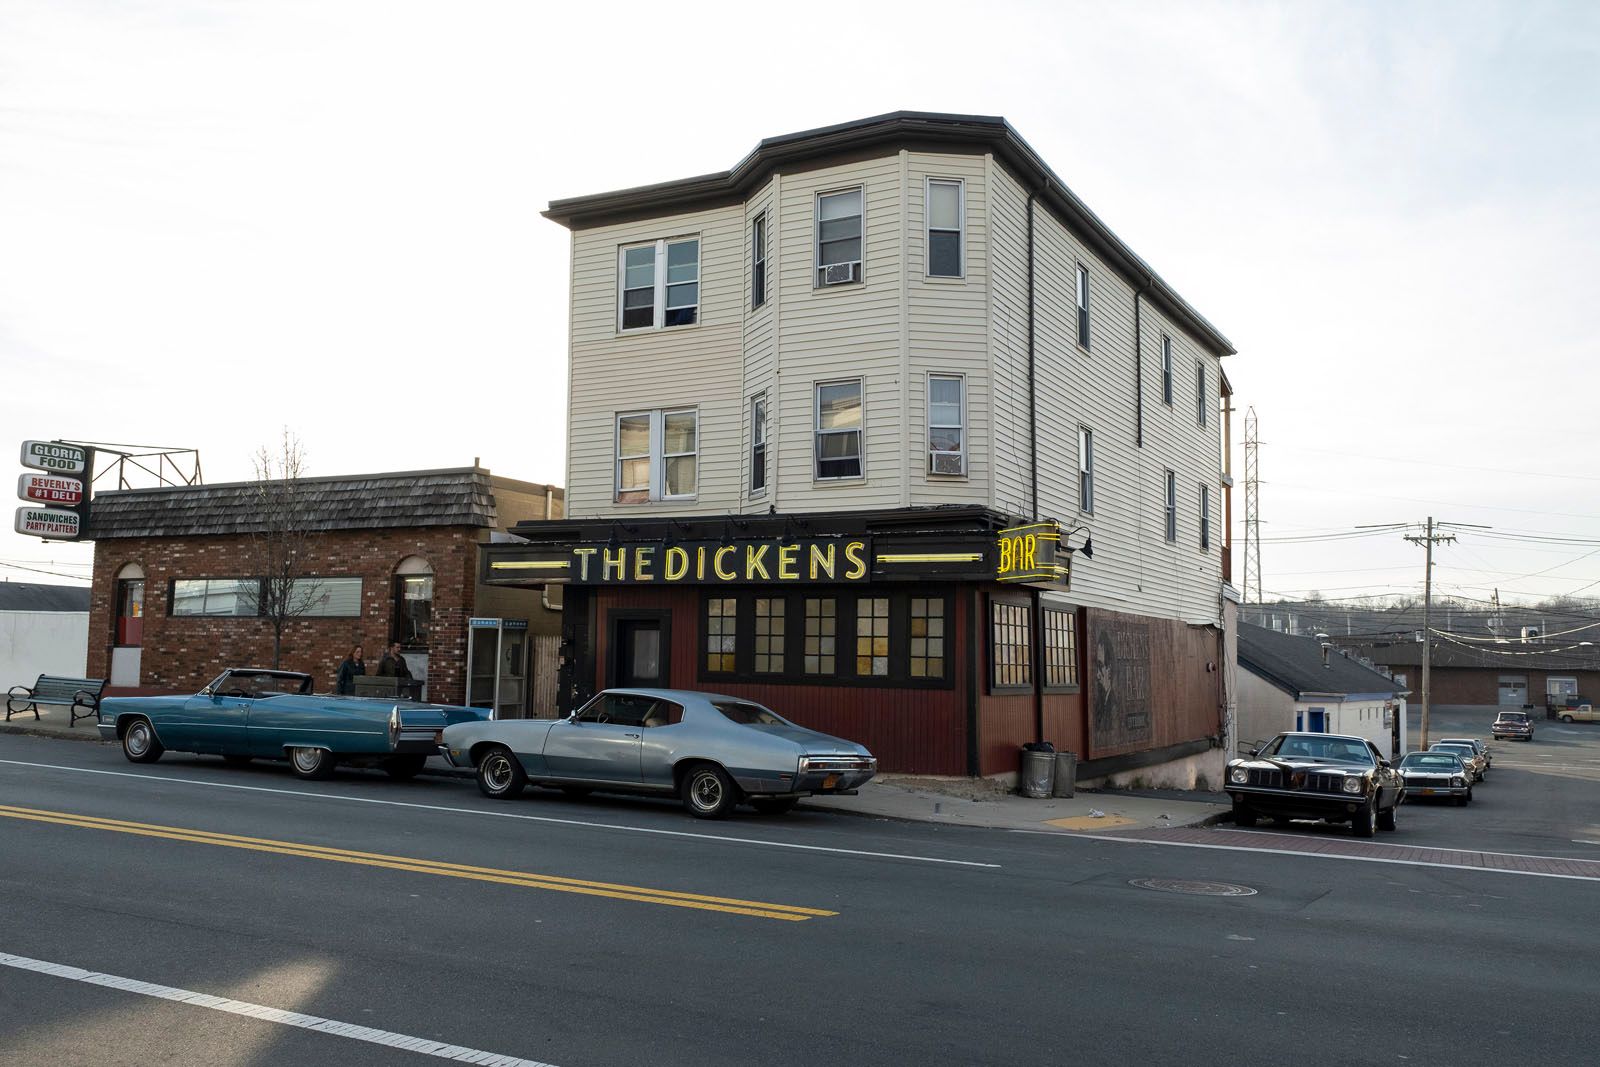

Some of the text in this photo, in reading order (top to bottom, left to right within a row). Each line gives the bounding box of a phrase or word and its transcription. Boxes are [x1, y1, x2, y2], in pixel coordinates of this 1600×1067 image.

[34, 445, 82, 460] GLORIA
[40, 457, 76, 470] FOOD
[31, 478, 80, 491] BEVERLY'S
[35, 489, 76, 500] #1 DELI
[27, 511, 78, 524] SANDWICHES
[26, 521, 77, 534] PARTY PLATTERS
[1000, 533, 1036, 573] BAR
[574, 542, 867, 581] THE DICKENS
